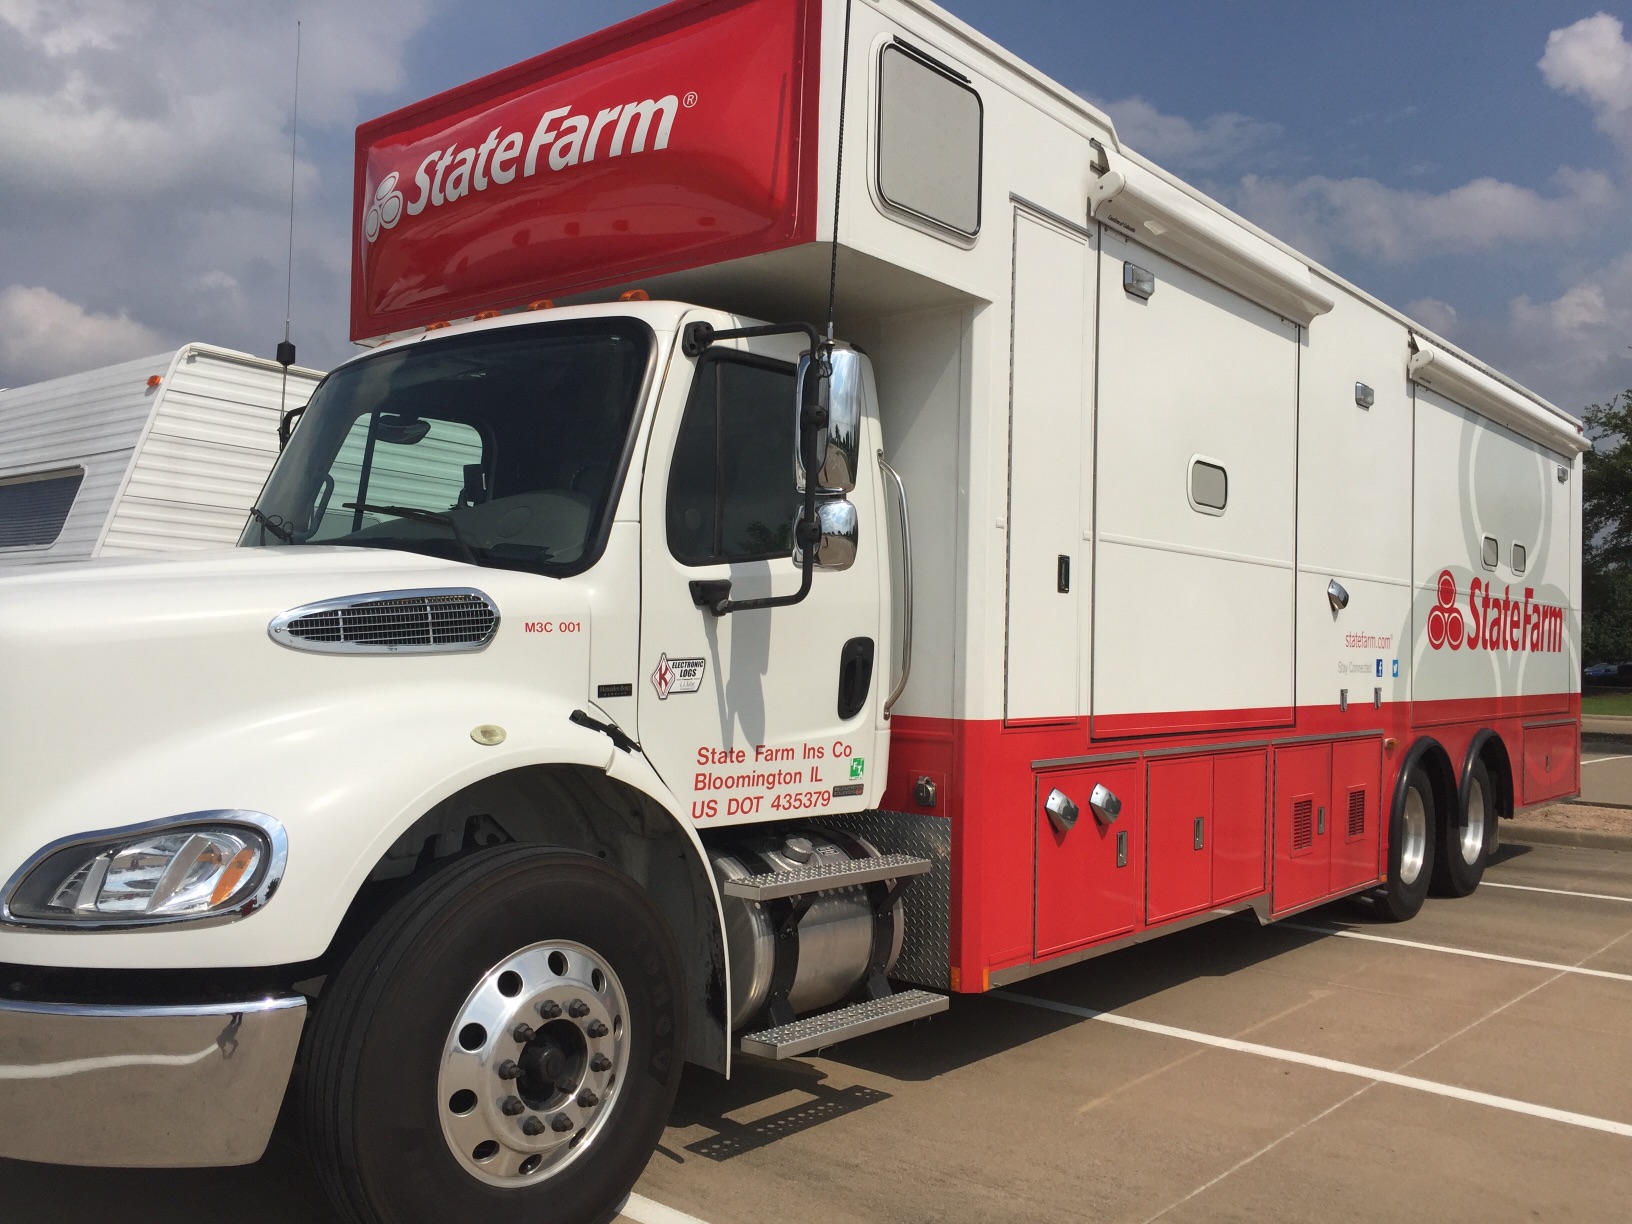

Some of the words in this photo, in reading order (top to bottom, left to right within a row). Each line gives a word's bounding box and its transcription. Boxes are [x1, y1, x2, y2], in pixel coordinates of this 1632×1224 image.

[525, 621, 553, 633] M3C
[559, 621, 581, 633] 001
[1345, 631, 1391, 650] statefarm.com
[672, 661, 704, 669] ELECTRONIC
[680, 669, 697, 678] LOGS
[696, 746, 746, 766] State
[755, 744, 795, 762] Farm
[802, 743, 825, 760] Ins
[832, 741, 853, 758] Co
[694, 769, 803, 791] Bloomington
[810, 766, 823, 782] IL
[691, 799, 718, 819] US
[727, 795, 764, 816] DOT
[770, 789, 831, 811] 435379
